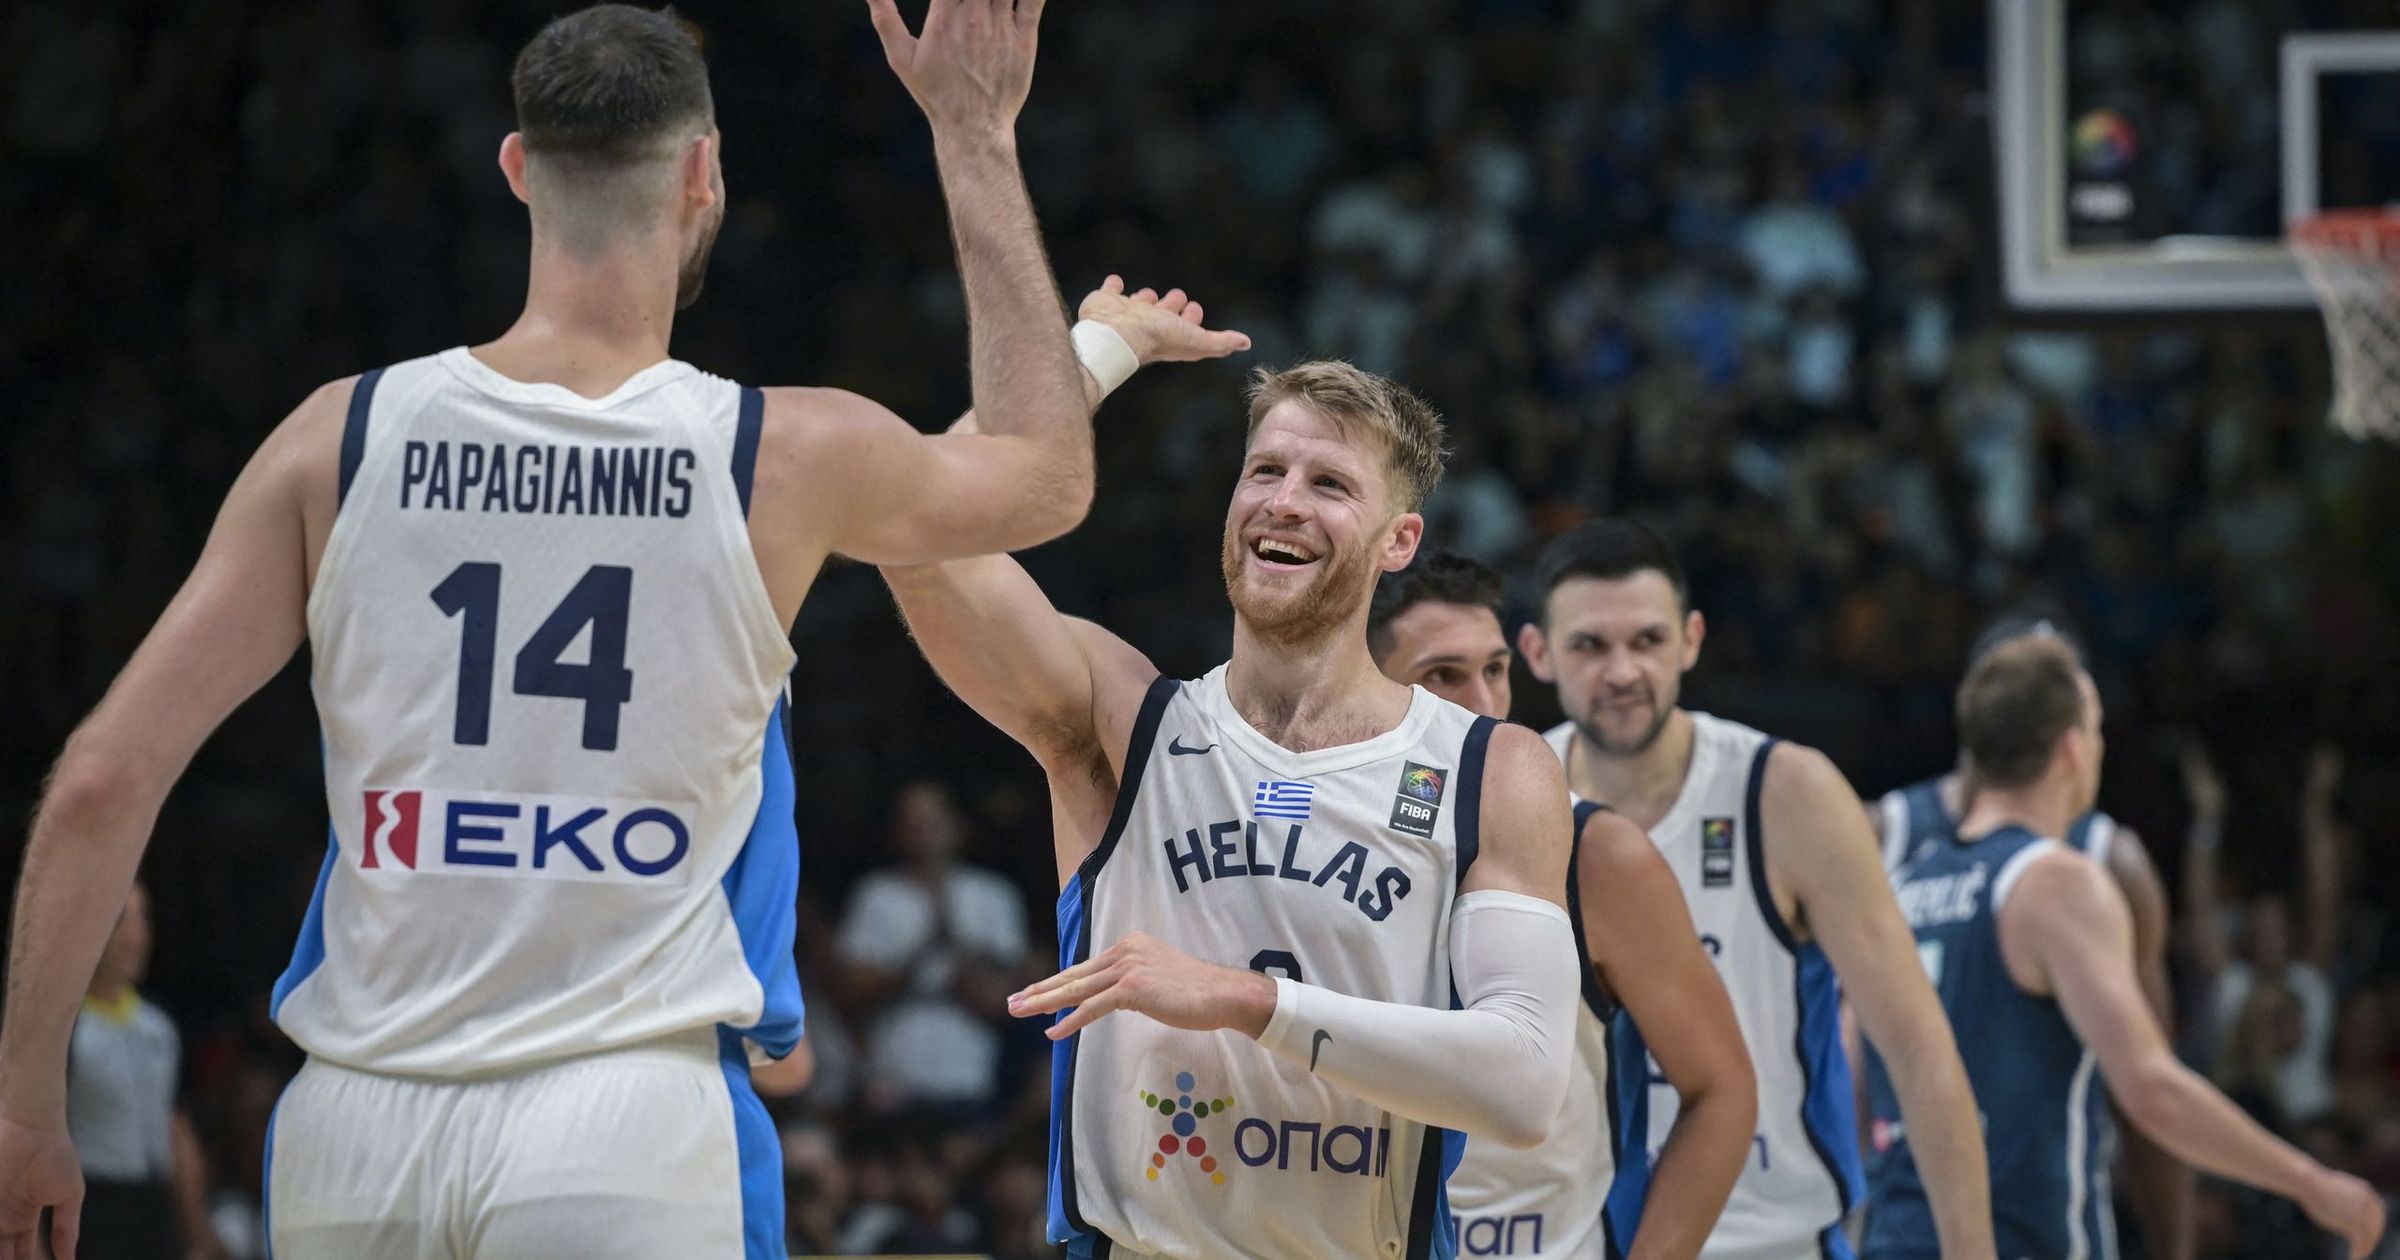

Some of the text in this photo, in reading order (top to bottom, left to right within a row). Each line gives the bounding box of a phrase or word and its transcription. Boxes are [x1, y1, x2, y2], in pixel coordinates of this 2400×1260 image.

[400, 441, 696, 519] PAPAGIANNIS
[430, 561, 633, 752] 14
[444, 800, 690, 876] EKO
[1400, 802, 1431, 821] FIBA
[1163, 819, 1412, 922] HELLAS
